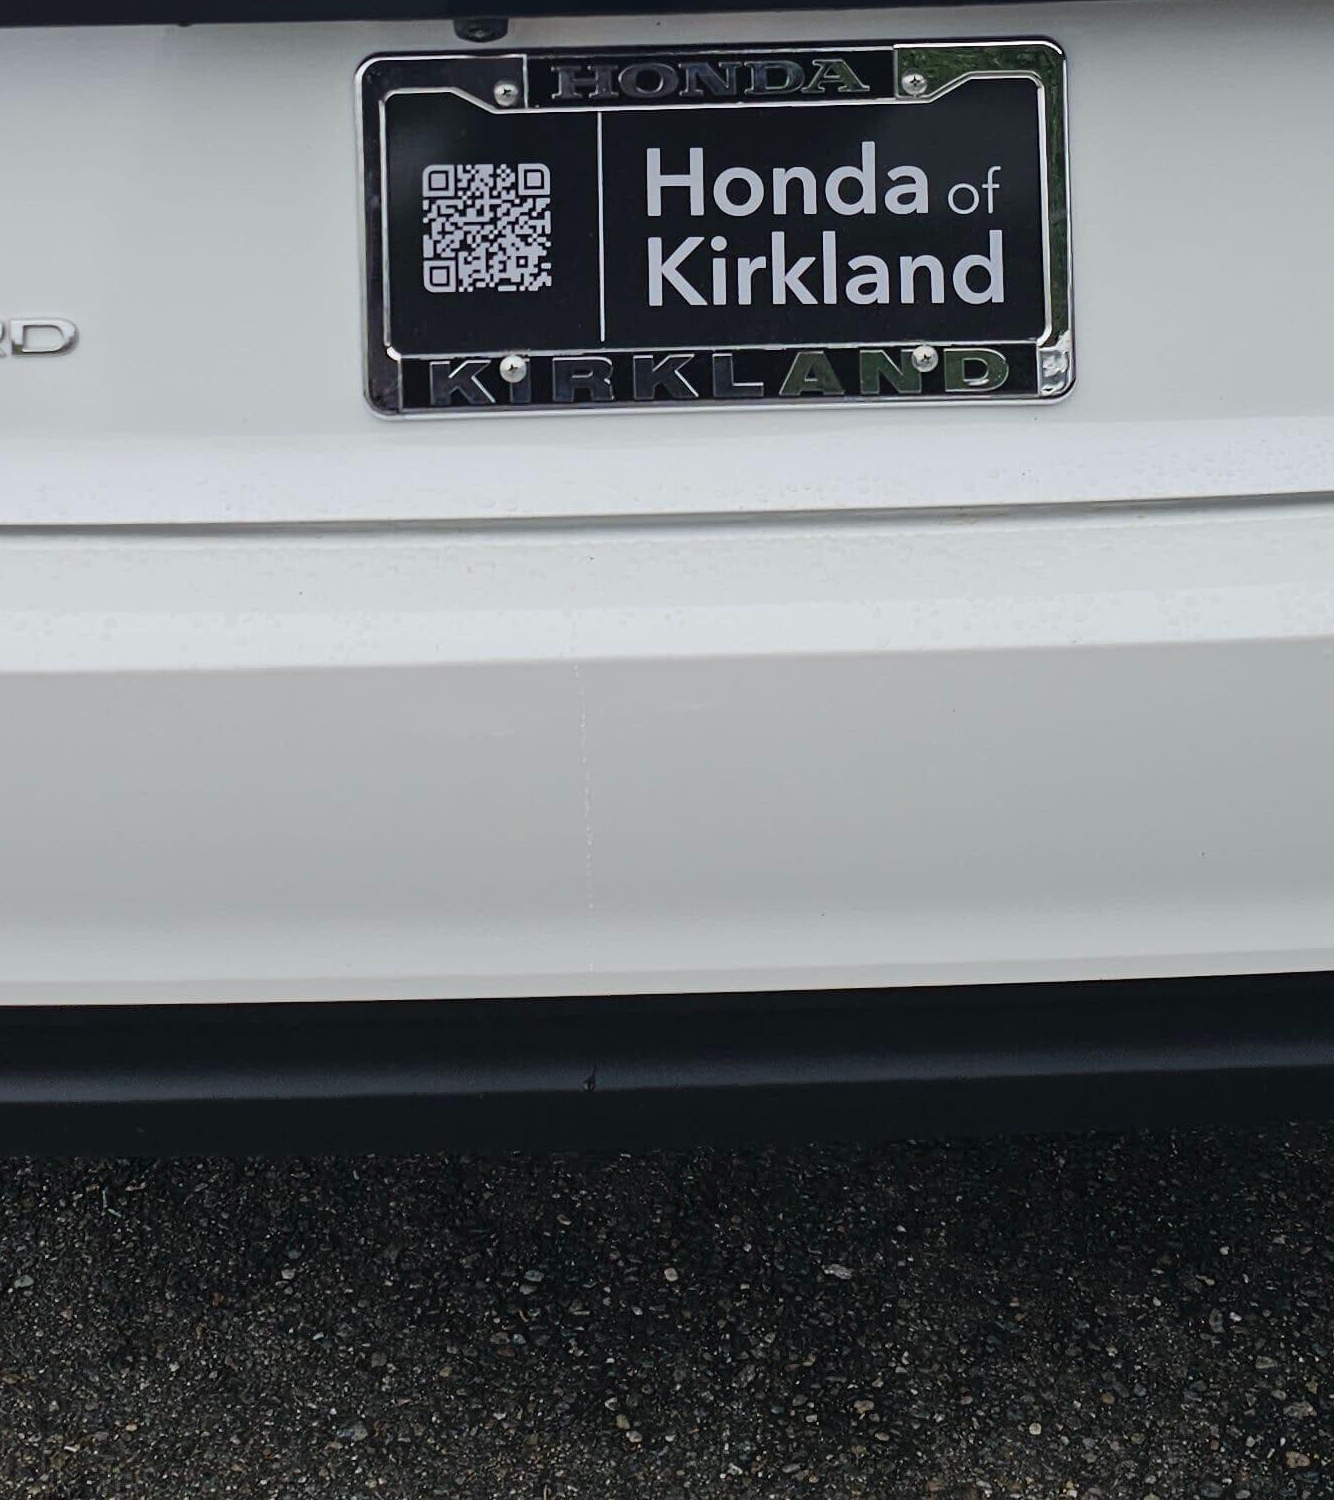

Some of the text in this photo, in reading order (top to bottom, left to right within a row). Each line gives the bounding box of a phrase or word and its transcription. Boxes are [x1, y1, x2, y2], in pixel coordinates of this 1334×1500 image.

[551, 58, 871, 100] HONDA
[646, 140, 1002, 217] Honda of
[647, 228, 1006, 307] Kirkland
